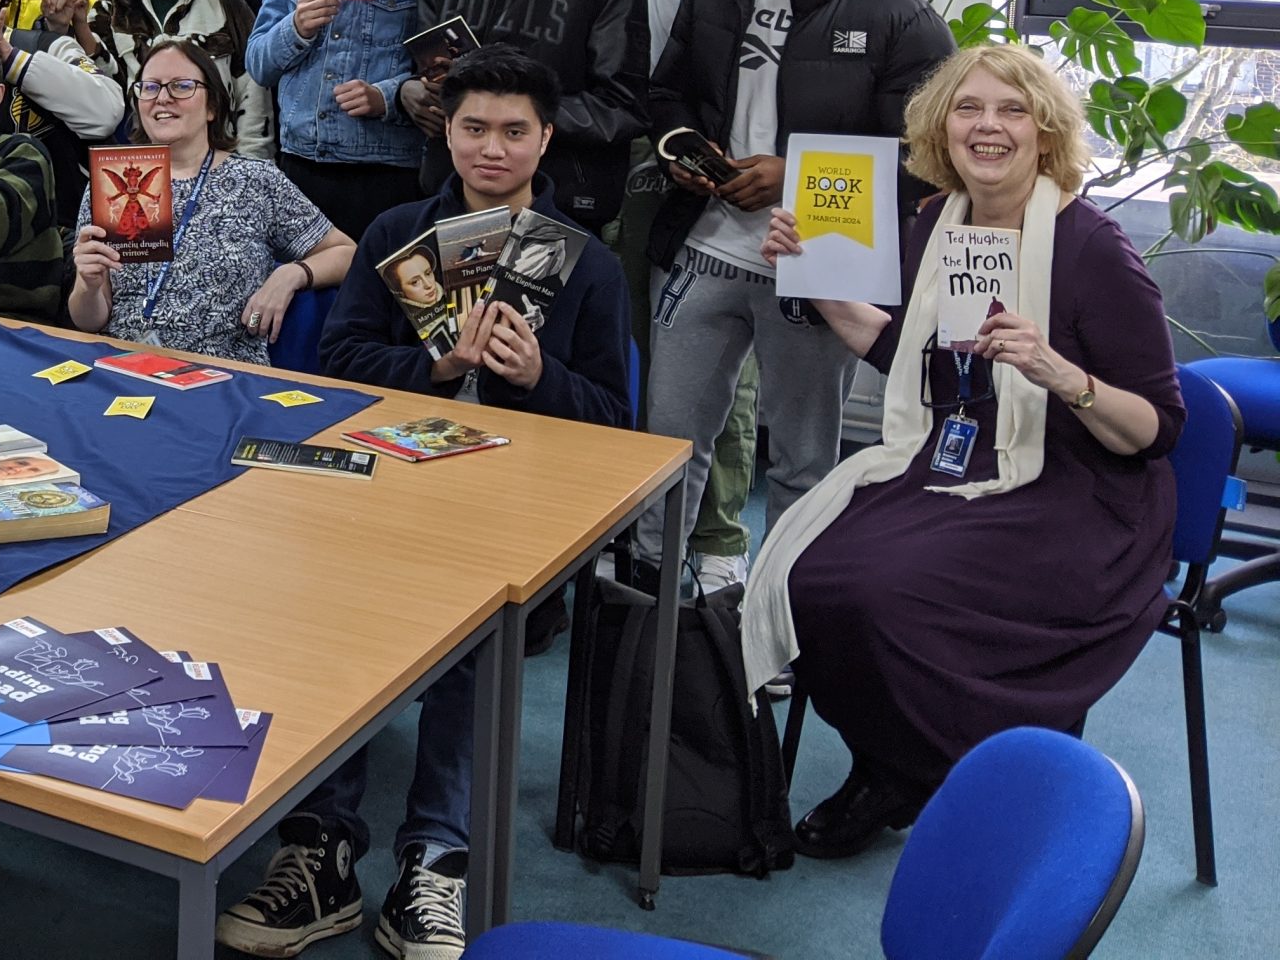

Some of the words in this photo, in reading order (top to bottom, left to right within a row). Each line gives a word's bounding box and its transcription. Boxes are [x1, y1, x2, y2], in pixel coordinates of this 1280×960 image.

[818, 166, 852, 176] WORLD
[806, 176, 863, 193] BOOK
[813, 193, 854, 209] DAY
[813, 215, 841, 223] MARCH
[945, 231, 964, 244] Ted
[969, 232, 1009, 245] Hughes
[942, 255, 961, 267] the
[965, 247, 1012, 271] Iron
[461, 269, 475, 277] The
[504, 272, 515, 282] The
[515, 277, 541, 291] Elephant
[542, 288, 554, 297] Man
[949, 272, 1000, 296] man
[418, 311, 435, 323] Mary,
